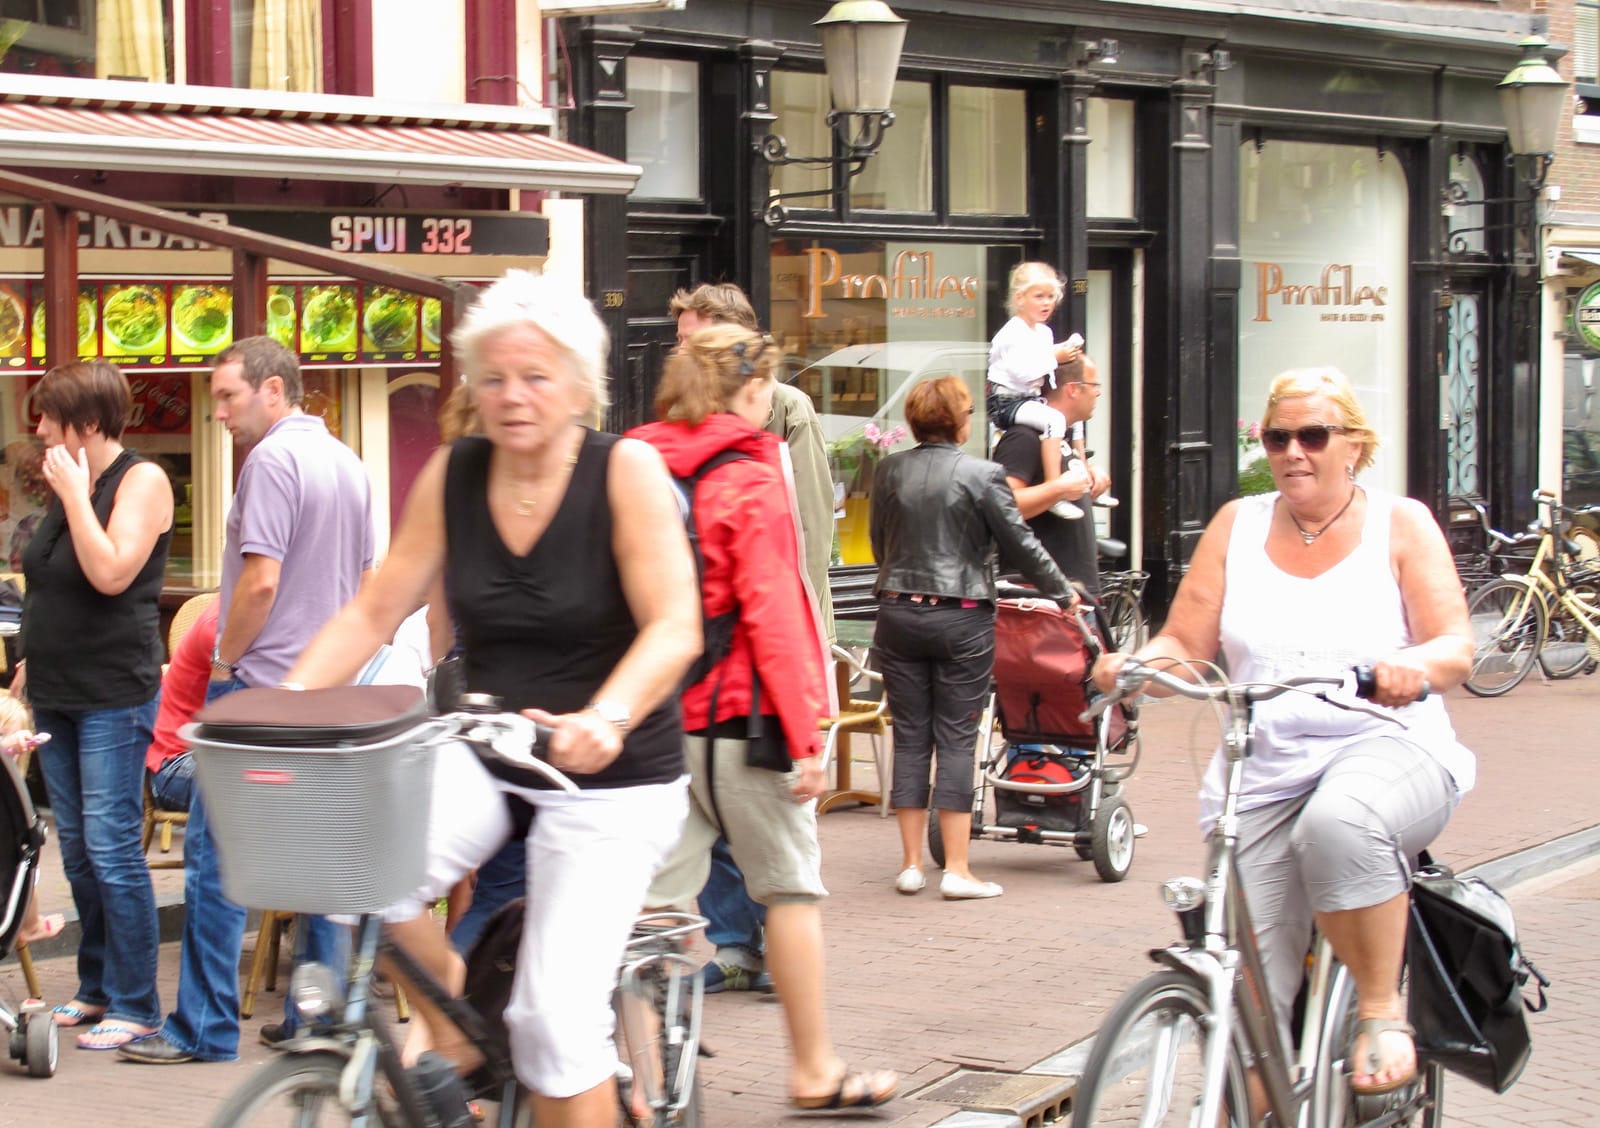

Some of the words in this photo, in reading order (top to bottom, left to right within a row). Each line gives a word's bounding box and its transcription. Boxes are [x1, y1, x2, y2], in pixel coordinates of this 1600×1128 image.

[330, 216, 407, 253] SPUI
[421, 218, 473, 254] 332
[802, 247, 979, 318] Profiles
[1251, 261, 1387, 322] Profiles
